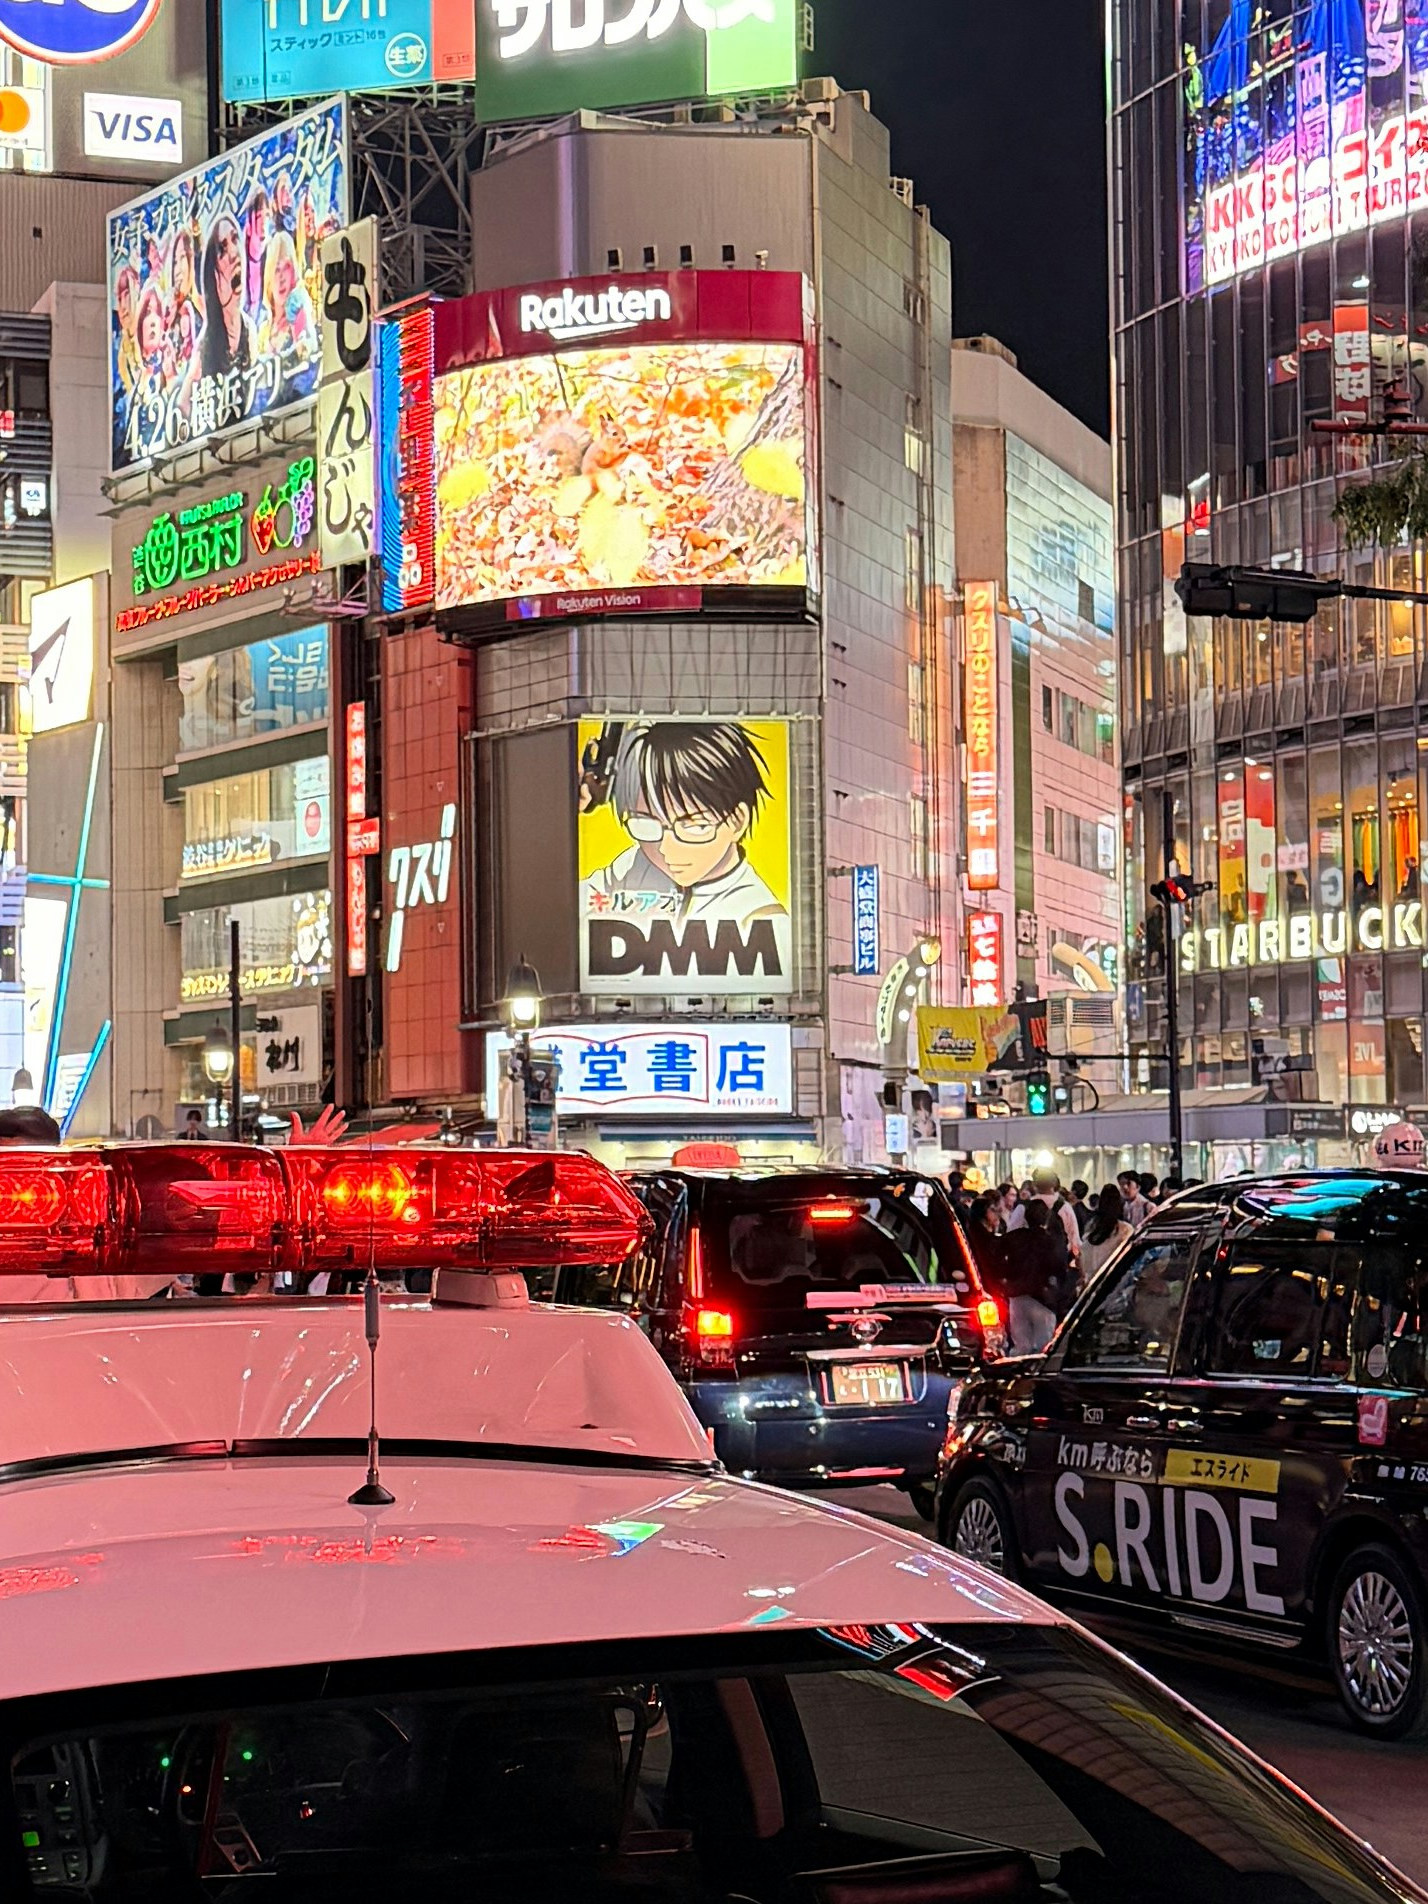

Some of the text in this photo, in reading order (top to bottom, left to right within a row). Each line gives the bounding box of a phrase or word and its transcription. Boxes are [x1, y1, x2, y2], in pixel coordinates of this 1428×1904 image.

[88, 109, 178, 145] VISA
[520, 285, 671, 336] Rakuten
[323, 235, 373, 551] もんじゃ
[180, 513, 244, 580] 西村
[556, 593, 641, 610] Rakuten Vision
[970, 589, 992, 759] クスリのことなら
[587, 889, 681, 915] キルアオ
[588, 918, 783, 977] DMM
[1190, 1457, 1252, 1484] エスライド
[1054, 1470, 1286, 1617] S.RIDE
